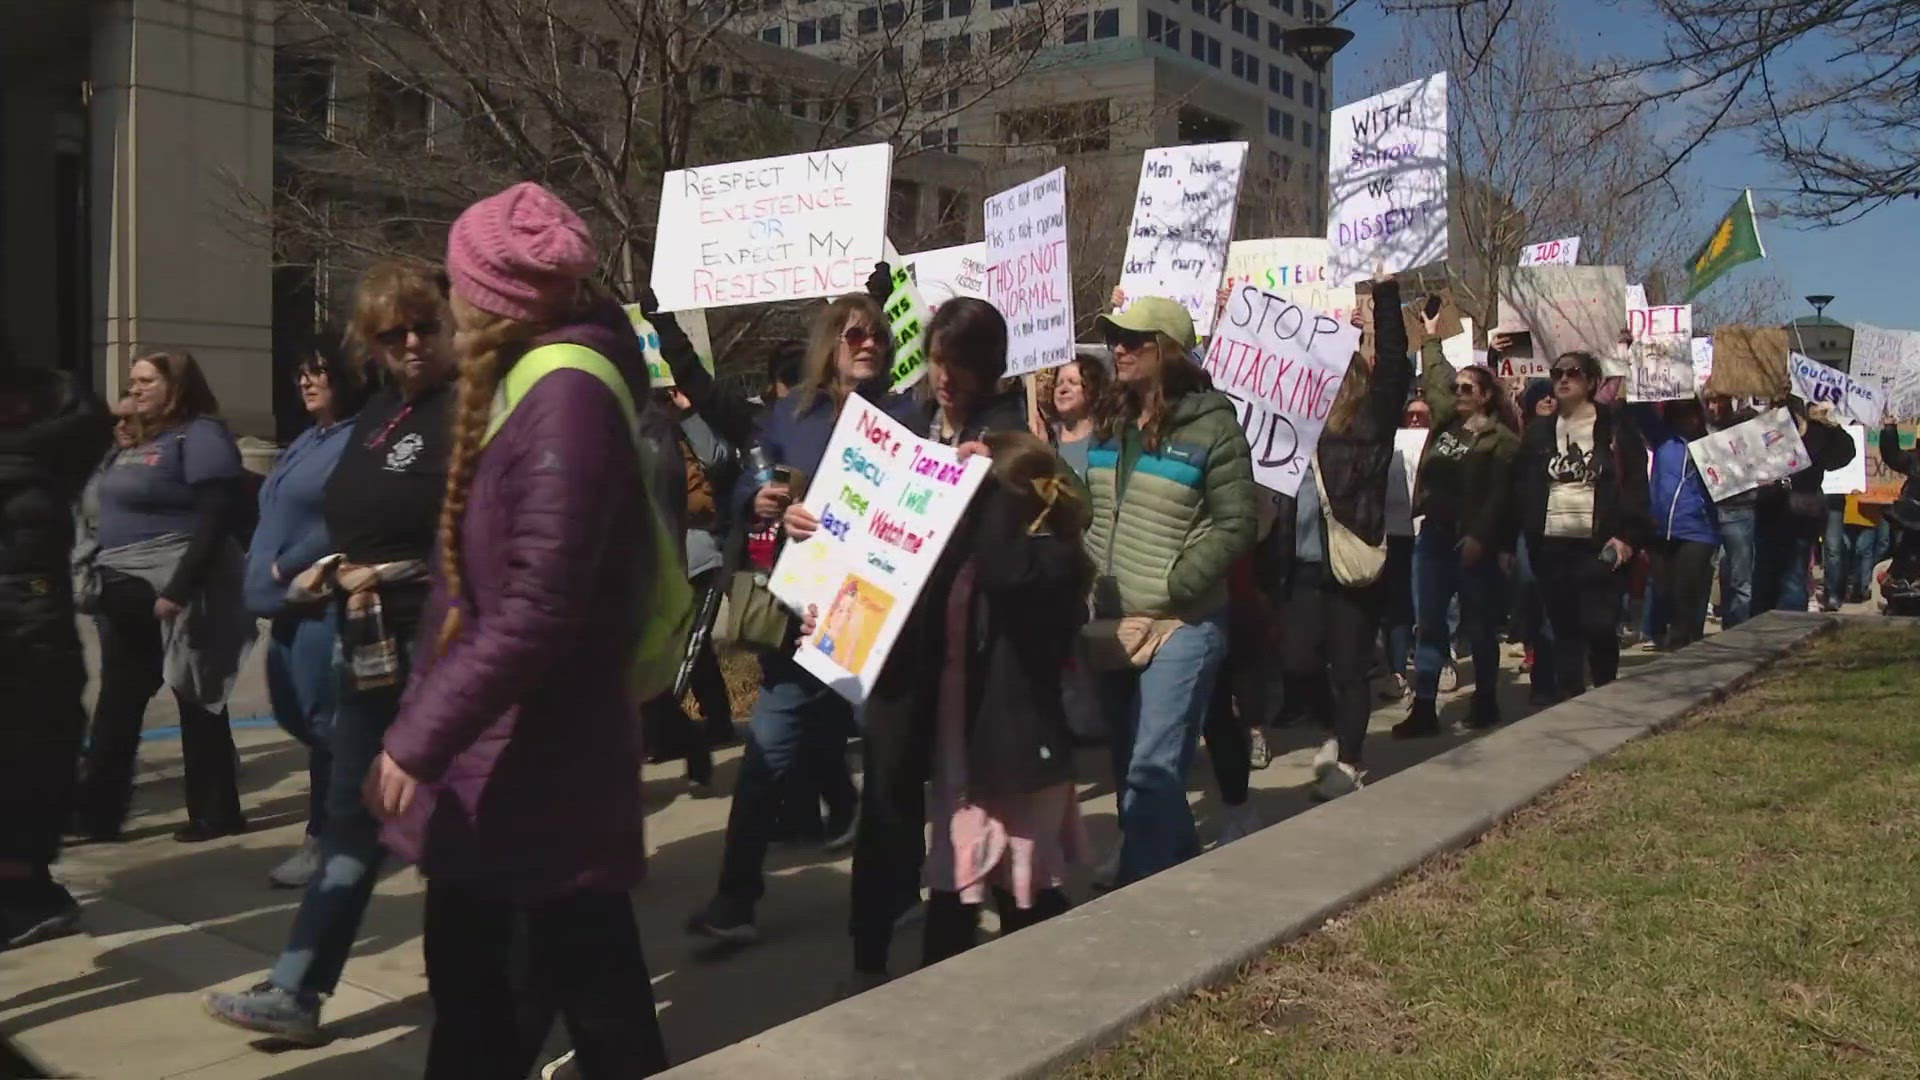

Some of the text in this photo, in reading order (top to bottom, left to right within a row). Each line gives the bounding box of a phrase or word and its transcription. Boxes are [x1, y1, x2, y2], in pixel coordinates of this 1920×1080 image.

[1352, 100, 1412, 136] WITH
[684, 167, 784, 197] RESPECT
[1140, 192, 1152, 206] to
[700, 188, 852, 224] EXISTENCE
[1338, 202, 1428, 246] DISSENT
[749, 218, 784, 239] OR
[701, 241, 793, 266] EXPECT
[986, 240, 1065, 297] THIS IS NOT
[1534, 240, 1561, 262] IUD
[693, 257, 873, 303] RESISTENCE
[998, 277, 1061, 319] NORMAL
[1230, 285, 1340, 352] STOP
[1203, 335, 1341, 420] ATTACKING
[1794, 357, 1818, 378] You
